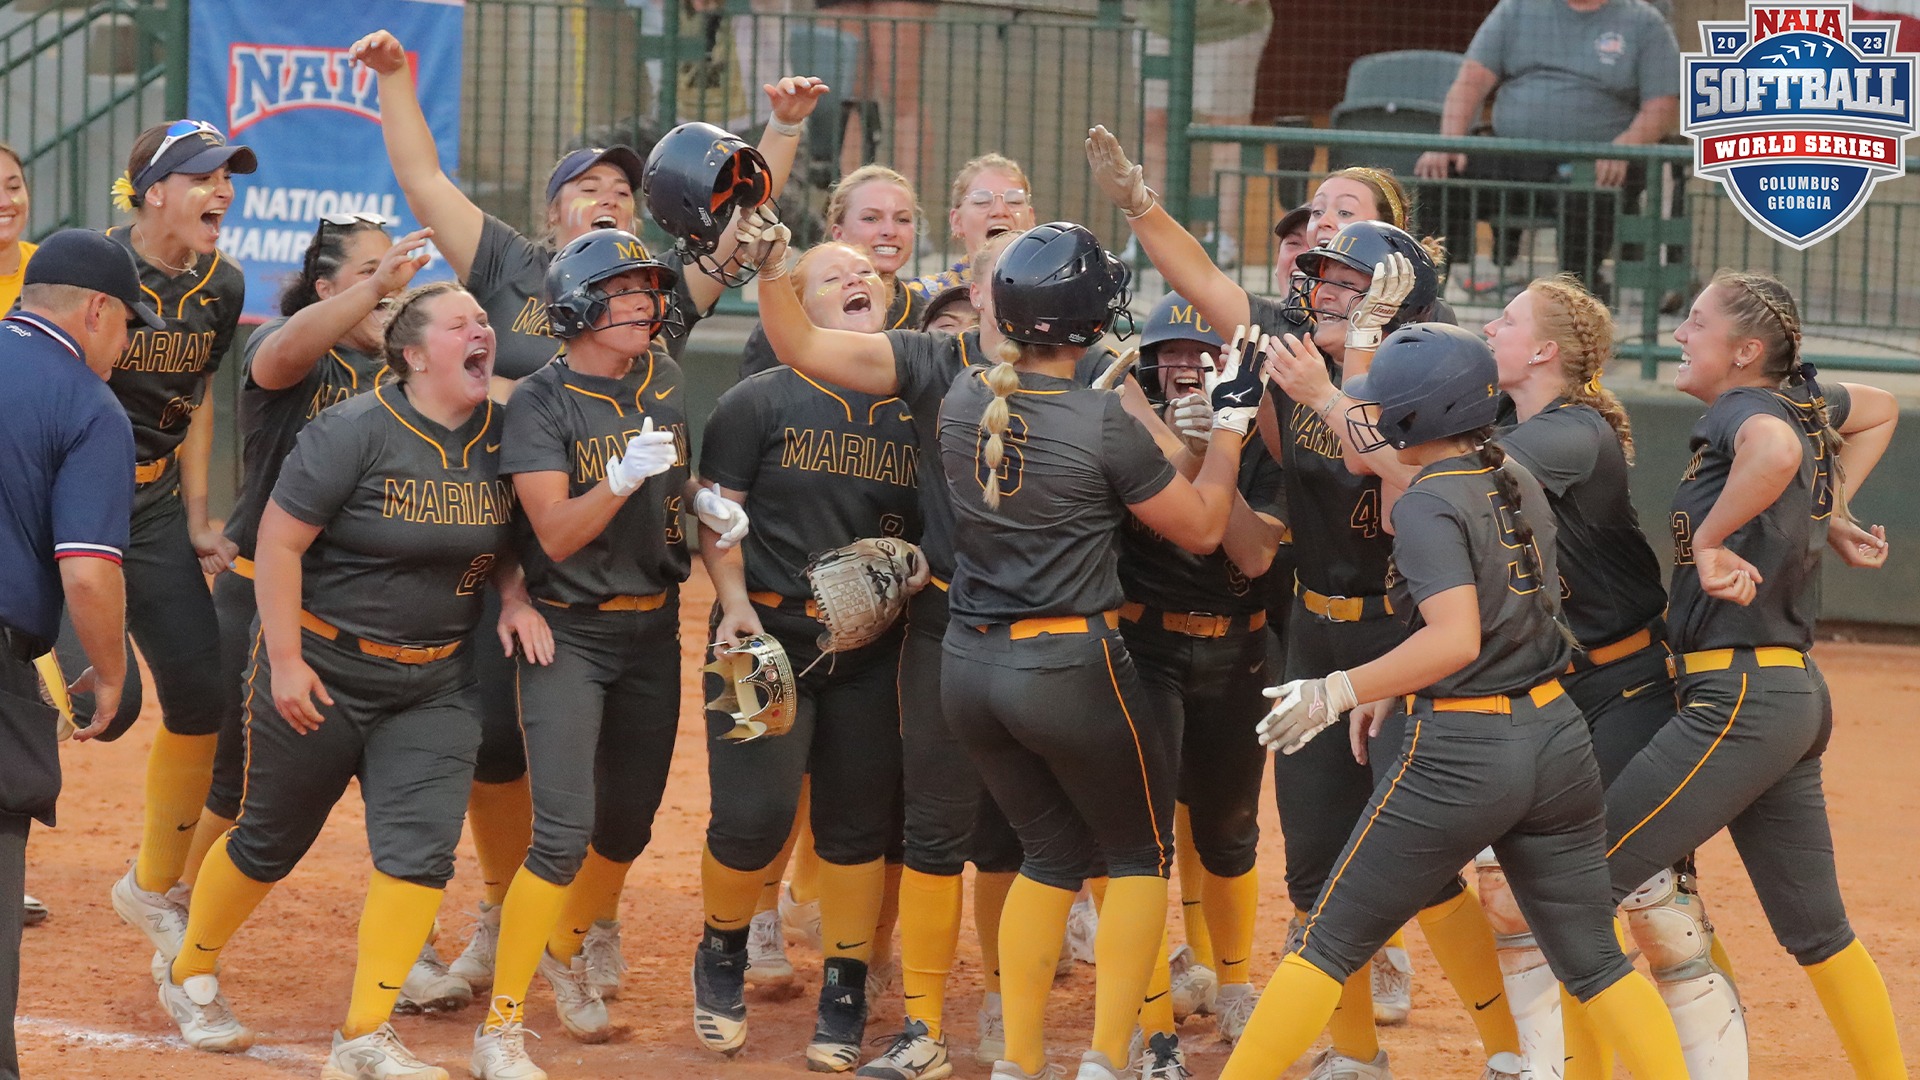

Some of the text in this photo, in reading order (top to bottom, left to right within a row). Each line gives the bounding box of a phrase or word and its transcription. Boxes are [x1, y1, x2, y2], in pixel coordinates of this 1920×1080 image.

[243, 186, 400, 228] NATIONAL
[112, 330, 216, 373] ARIAN
[1487, 385, 1494, 397] 5
[781, 427, 921, 489] MARIAN
[383, 478, 517, 526] MARIAN
[1350, 489, 1379, 539] 4
